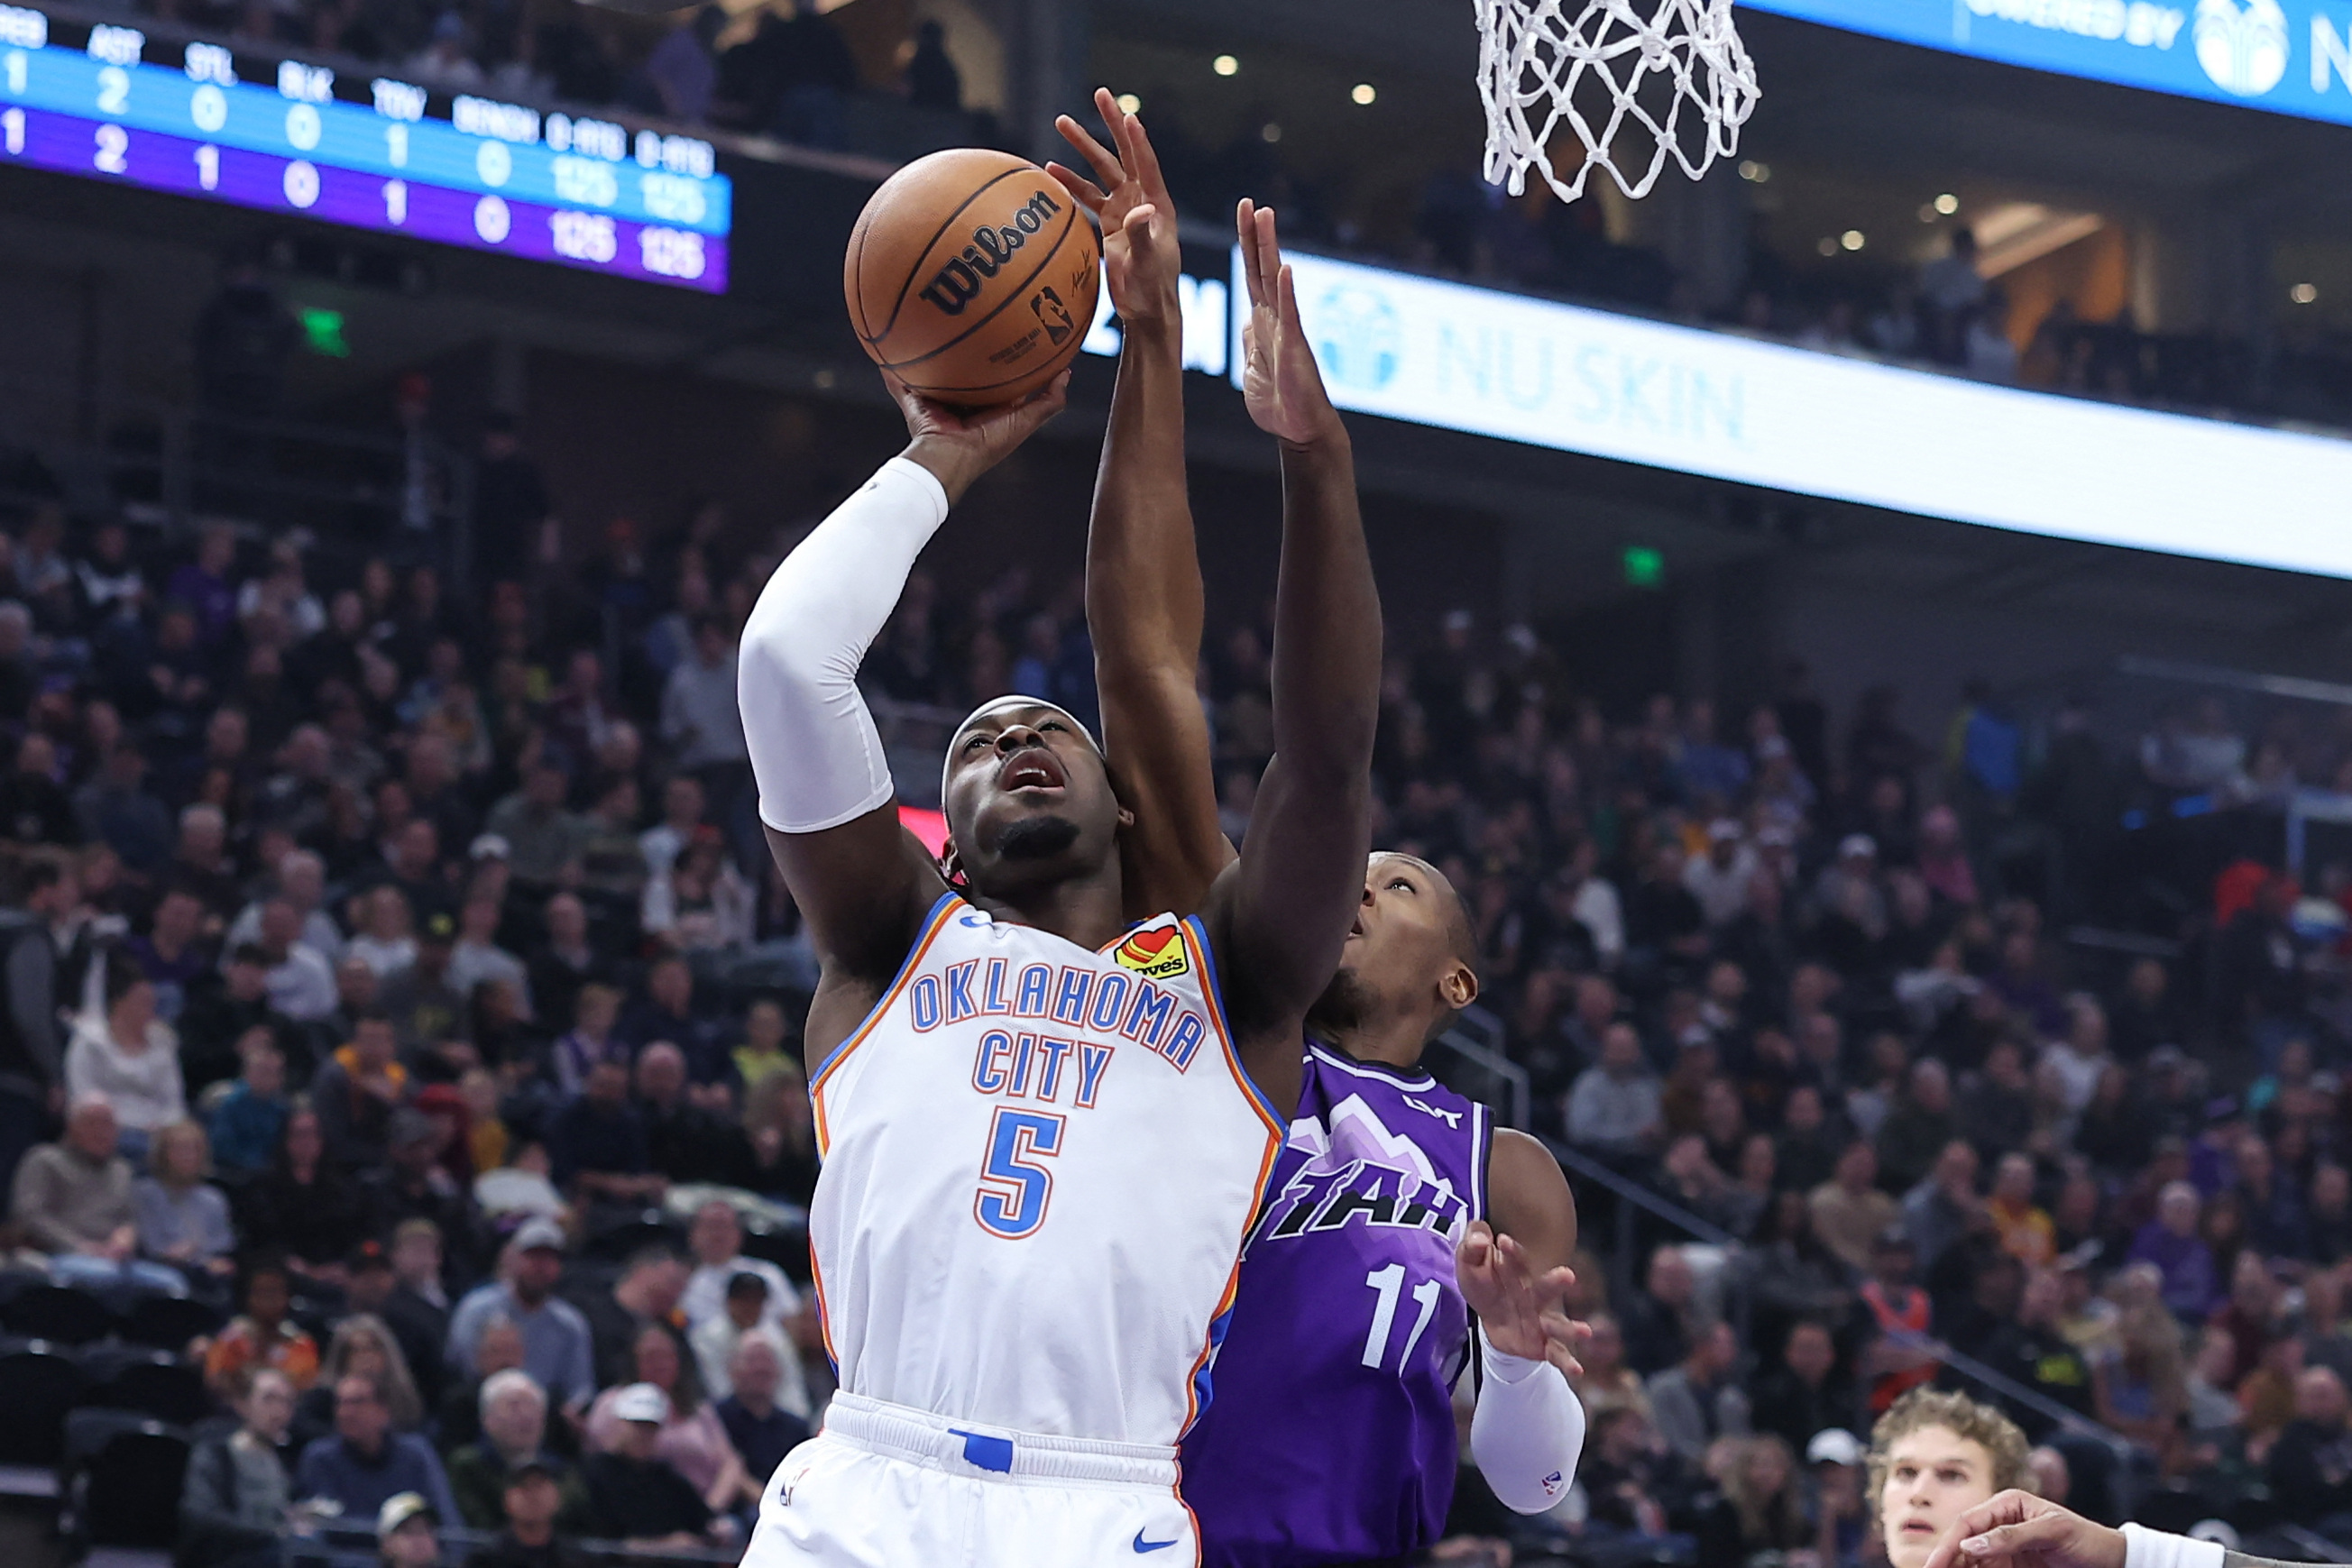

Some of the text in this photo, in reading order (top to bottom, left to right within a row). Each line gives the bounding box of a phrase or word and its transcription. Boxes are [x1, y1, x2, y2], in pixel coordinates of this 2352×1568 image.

[2125, 2, 2185, 50] BY
[2, 107, 706, 280] 1 2 1 0 1 0 125 125
[6, 49, 706, 225] 1 2 0 0 1 0 125 125
[918, 189, 1061, 316] Wilson
[1437, 317, 1747, 442] NU SKIN
[911, 958, 1206, 1075] OKLAHOMA
[971, 1029, 1115, 1109] CITY
[973, 1105, 1067, 1241] 5
[1241, 1158, 1469, 1262] TAH
[1361, 1262, 1441, 1380] 11
